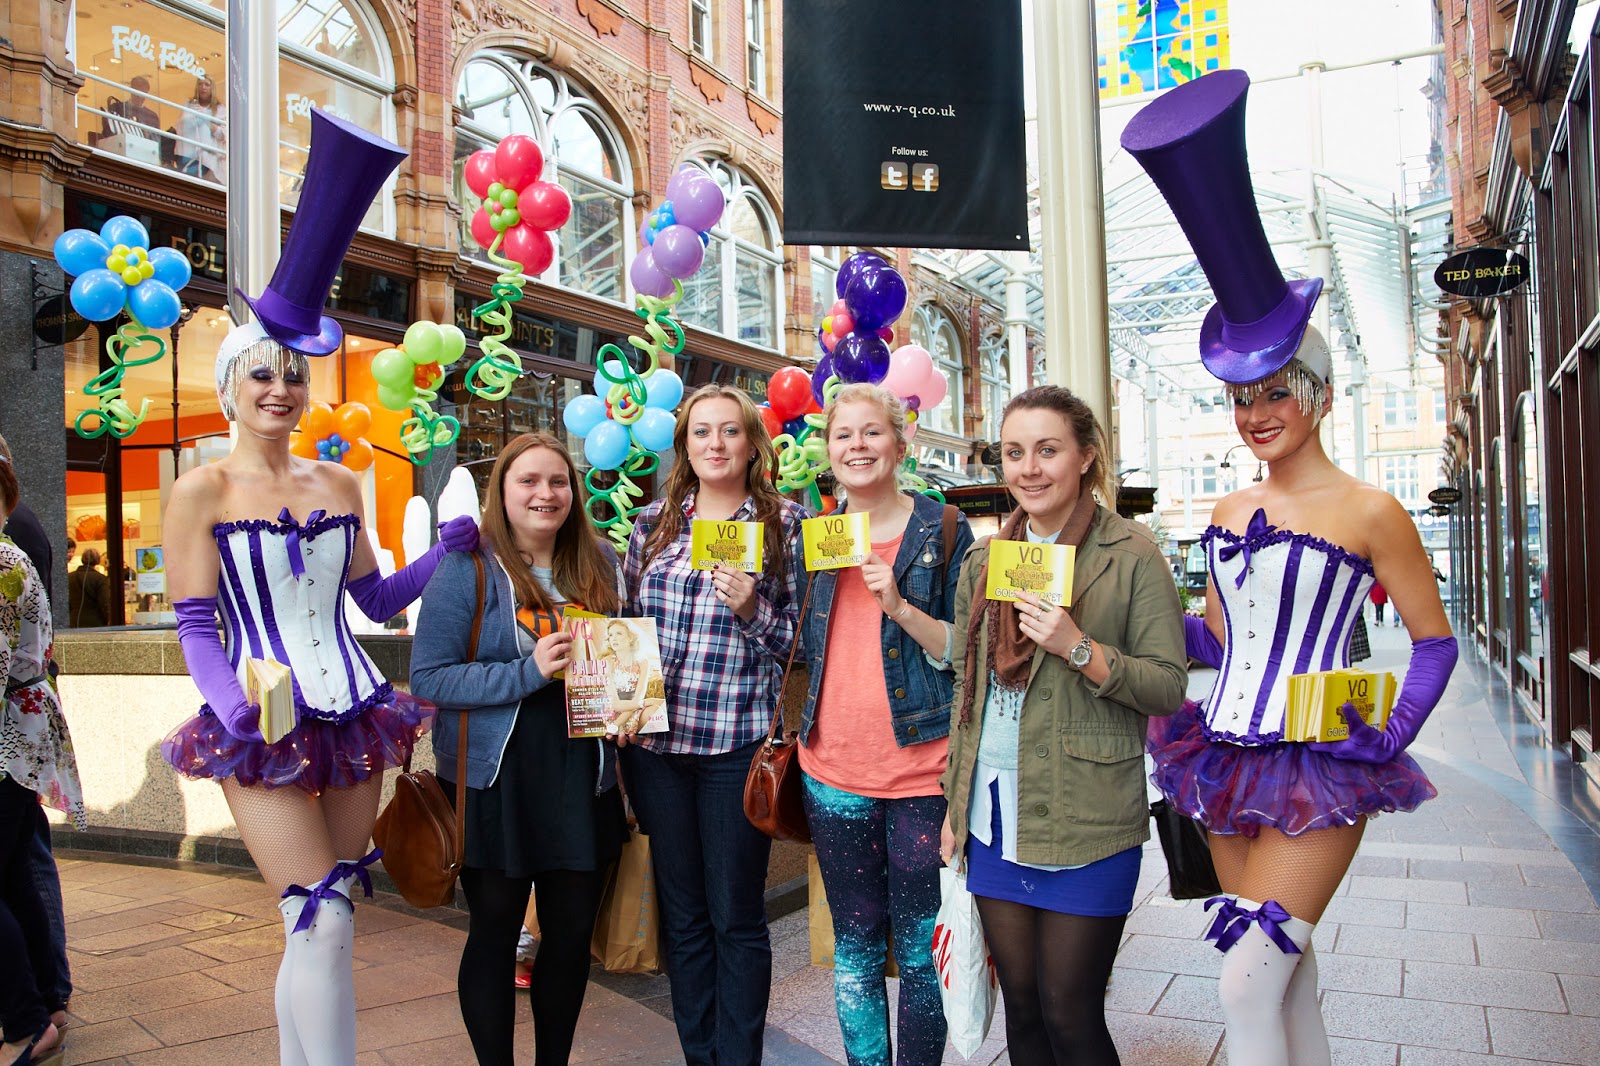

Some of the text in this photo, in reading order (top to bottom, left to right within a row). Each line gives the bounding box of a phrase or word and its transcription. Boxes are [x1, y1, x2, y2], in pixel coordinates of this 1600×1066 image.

[111, 25, 155, 61] Folli
[159, 41, 206, 80] Follie
[863, 103, 956, 118] www.v-q.co.uk
[891, 146, 929, 157] Follow us:
[1443, 265, 1521, 282] TED BAKER
[717, 524, 738, 540] VQ
[824, 518, 844, 535] VQ
[1019, 546, 1043, 565] VQ
[568, 620, 593, 640] VQ
[571, 659, 607, 676] CAMP
[1348, 678, 1368, 698] VQ
[1327, 727, 1349, 737] GOLD
